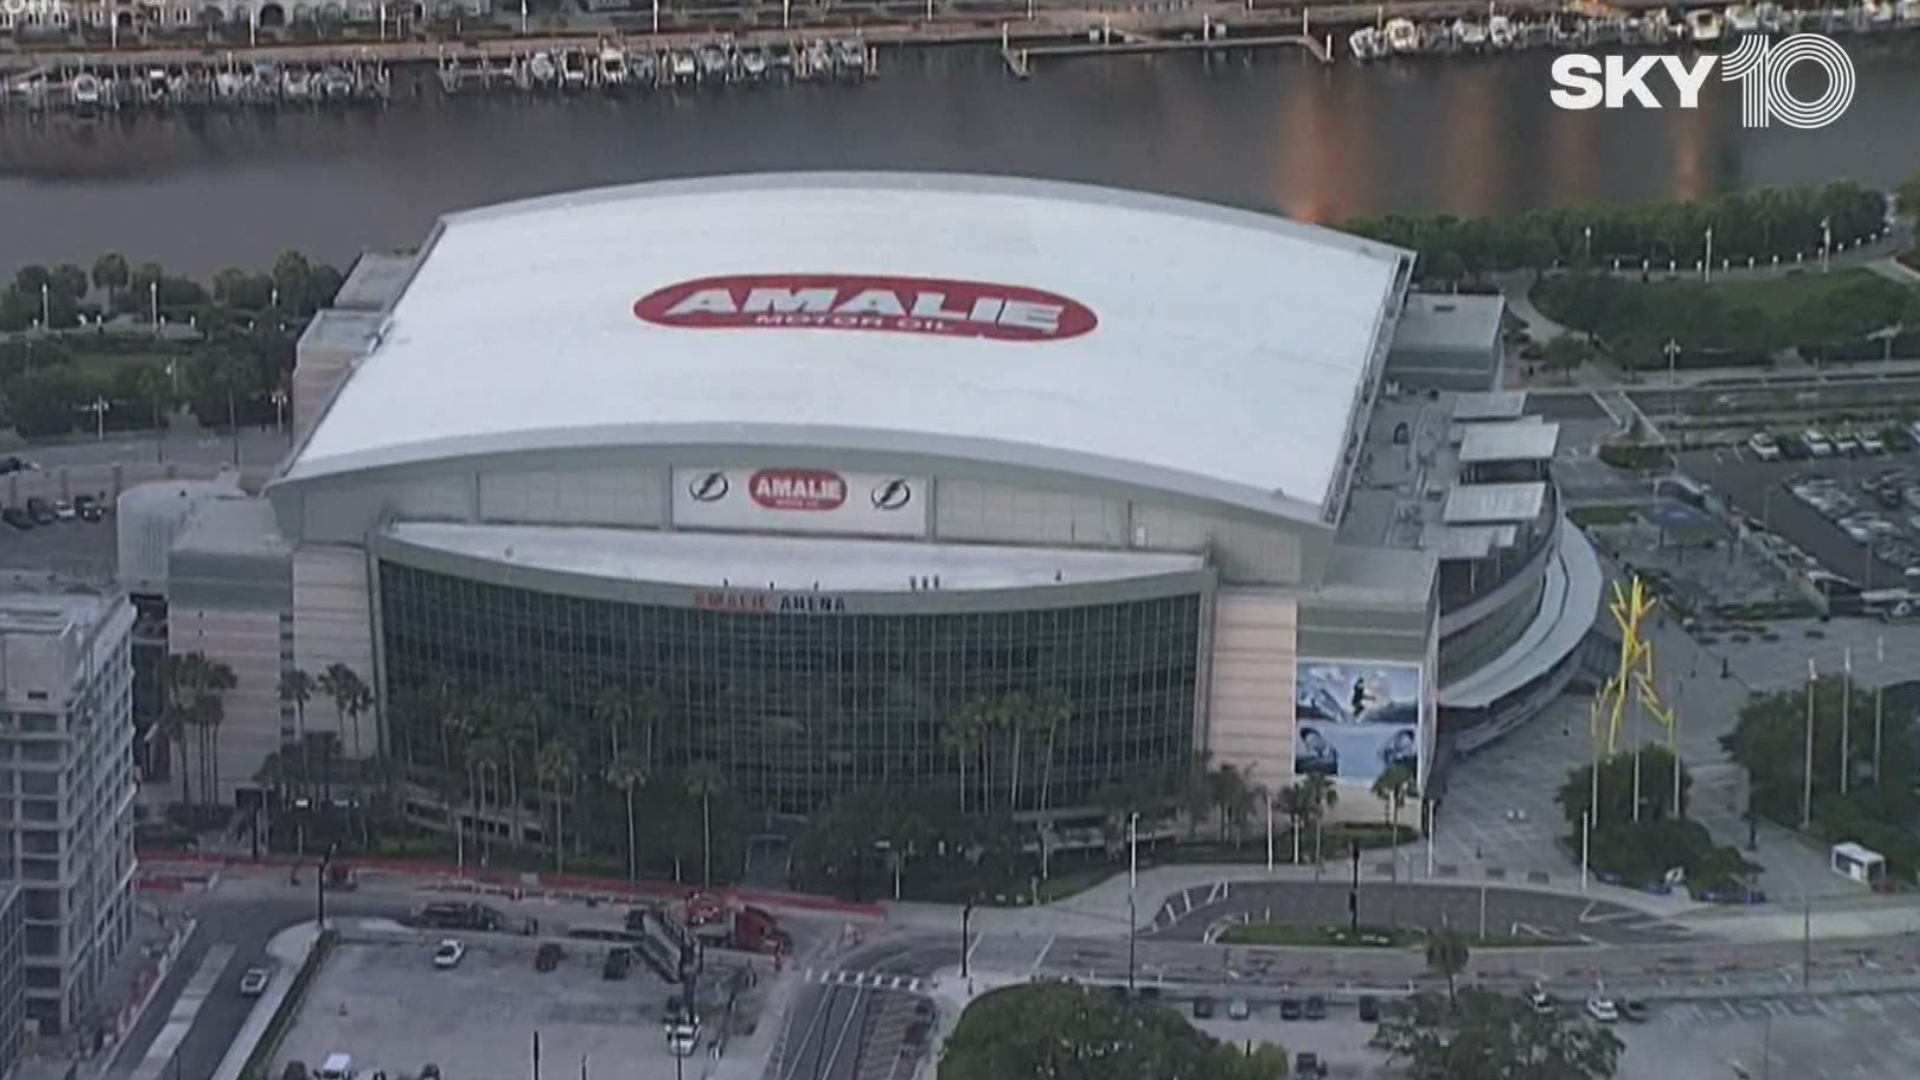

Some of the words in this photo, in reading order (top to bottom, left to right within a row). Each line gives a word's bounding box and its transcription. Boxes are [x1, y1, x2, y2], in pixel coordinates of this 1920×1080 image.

[663, 287, 1064, 334] AMALIE
[756, 314, 882, 327] MOTOR
[897, 317, 953, 330] OIL
[756, 478, 842, 500] AMALIE
[780, 594, 845, 611] ARENA
